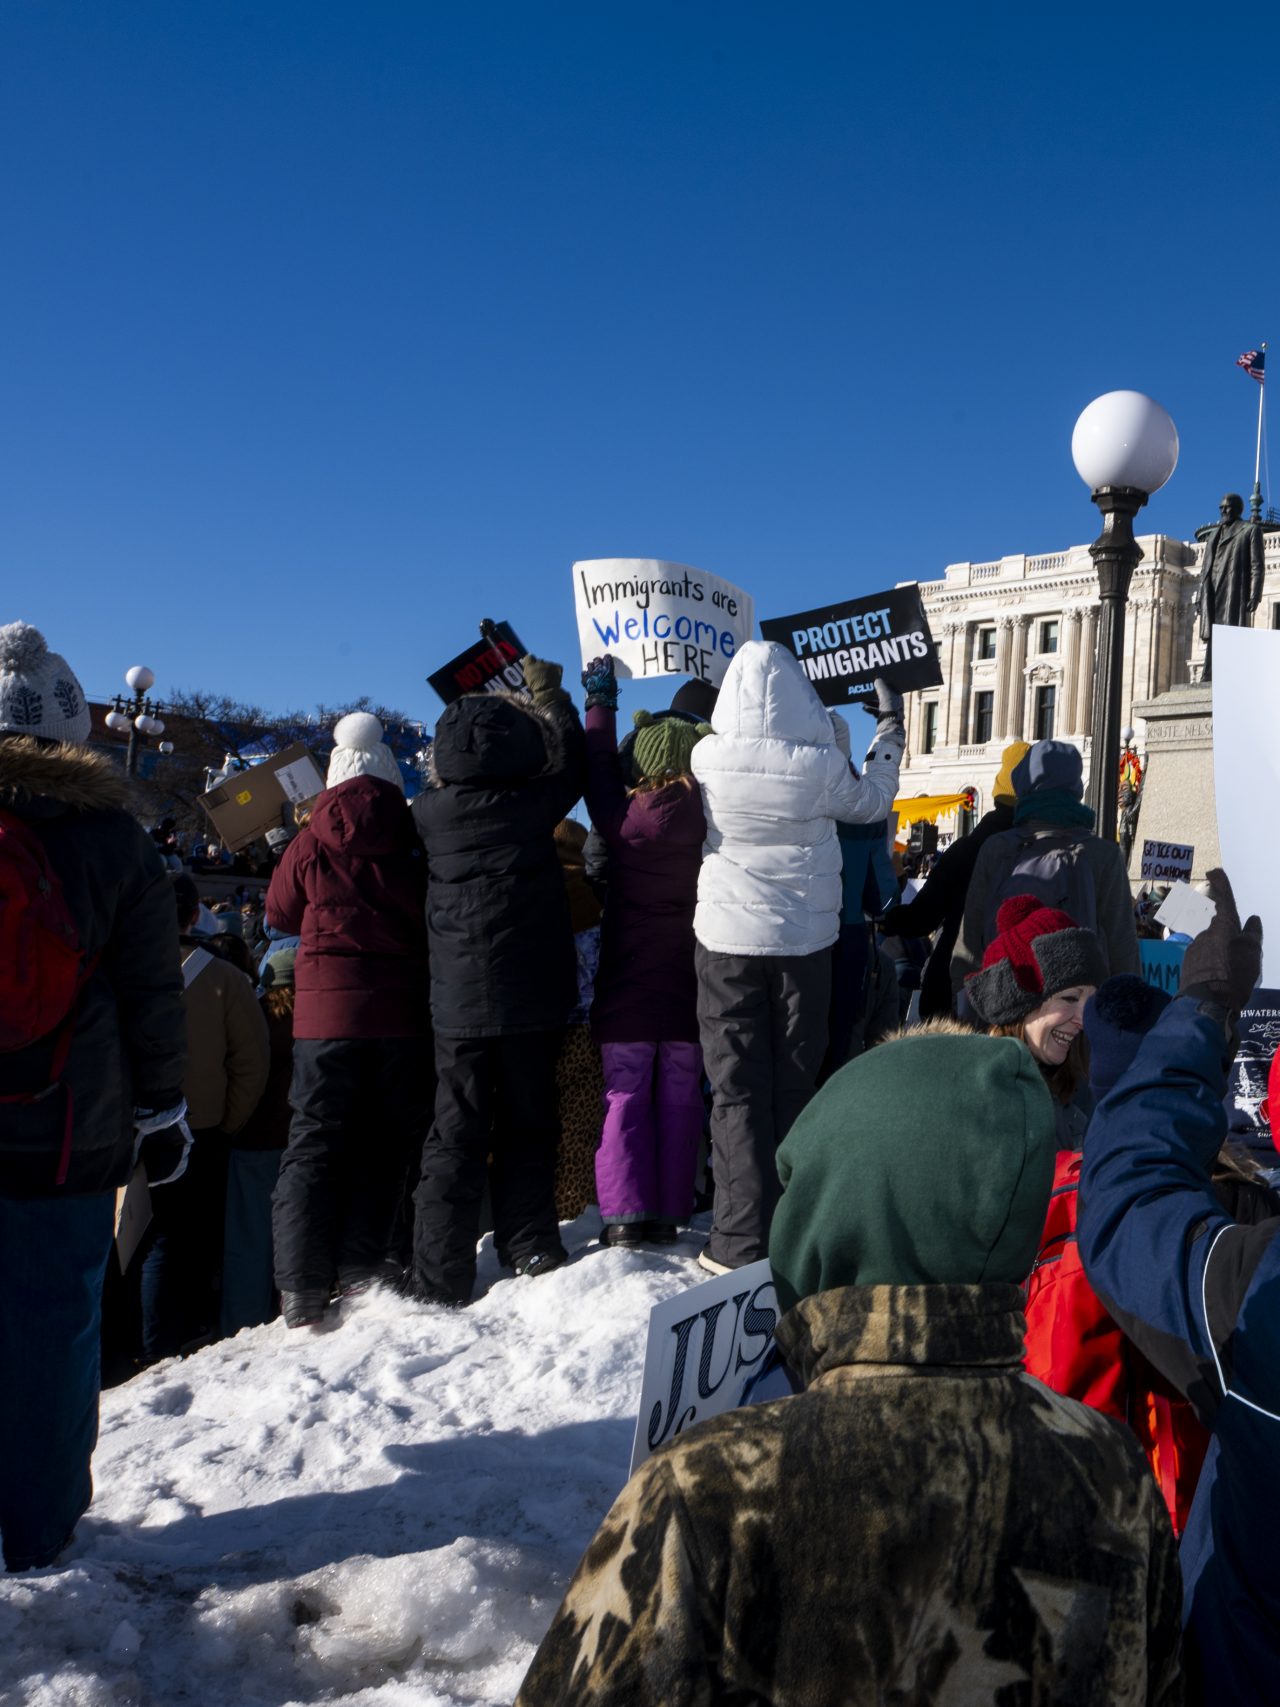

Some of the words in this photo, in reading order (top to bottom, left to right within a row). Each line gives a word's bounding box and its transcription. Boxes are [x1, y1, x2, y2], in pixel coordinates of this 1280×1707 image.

[581, 570, 704, 609] Immigrants
[712, 590, 738, 617] are
[592, 608, 735, 658] Welcome
[792, 608, 892, 656] PROTECT
[642, 641, 713, 684] HERE
[848, 682, 874, 695] ACLU
[1185, 723, 1213, 737] NELS
[1157, 843, 1170, 859] ICE
[1172, 847, 1193, 860] OUT
[1143, 863, 1152, 875] OF
